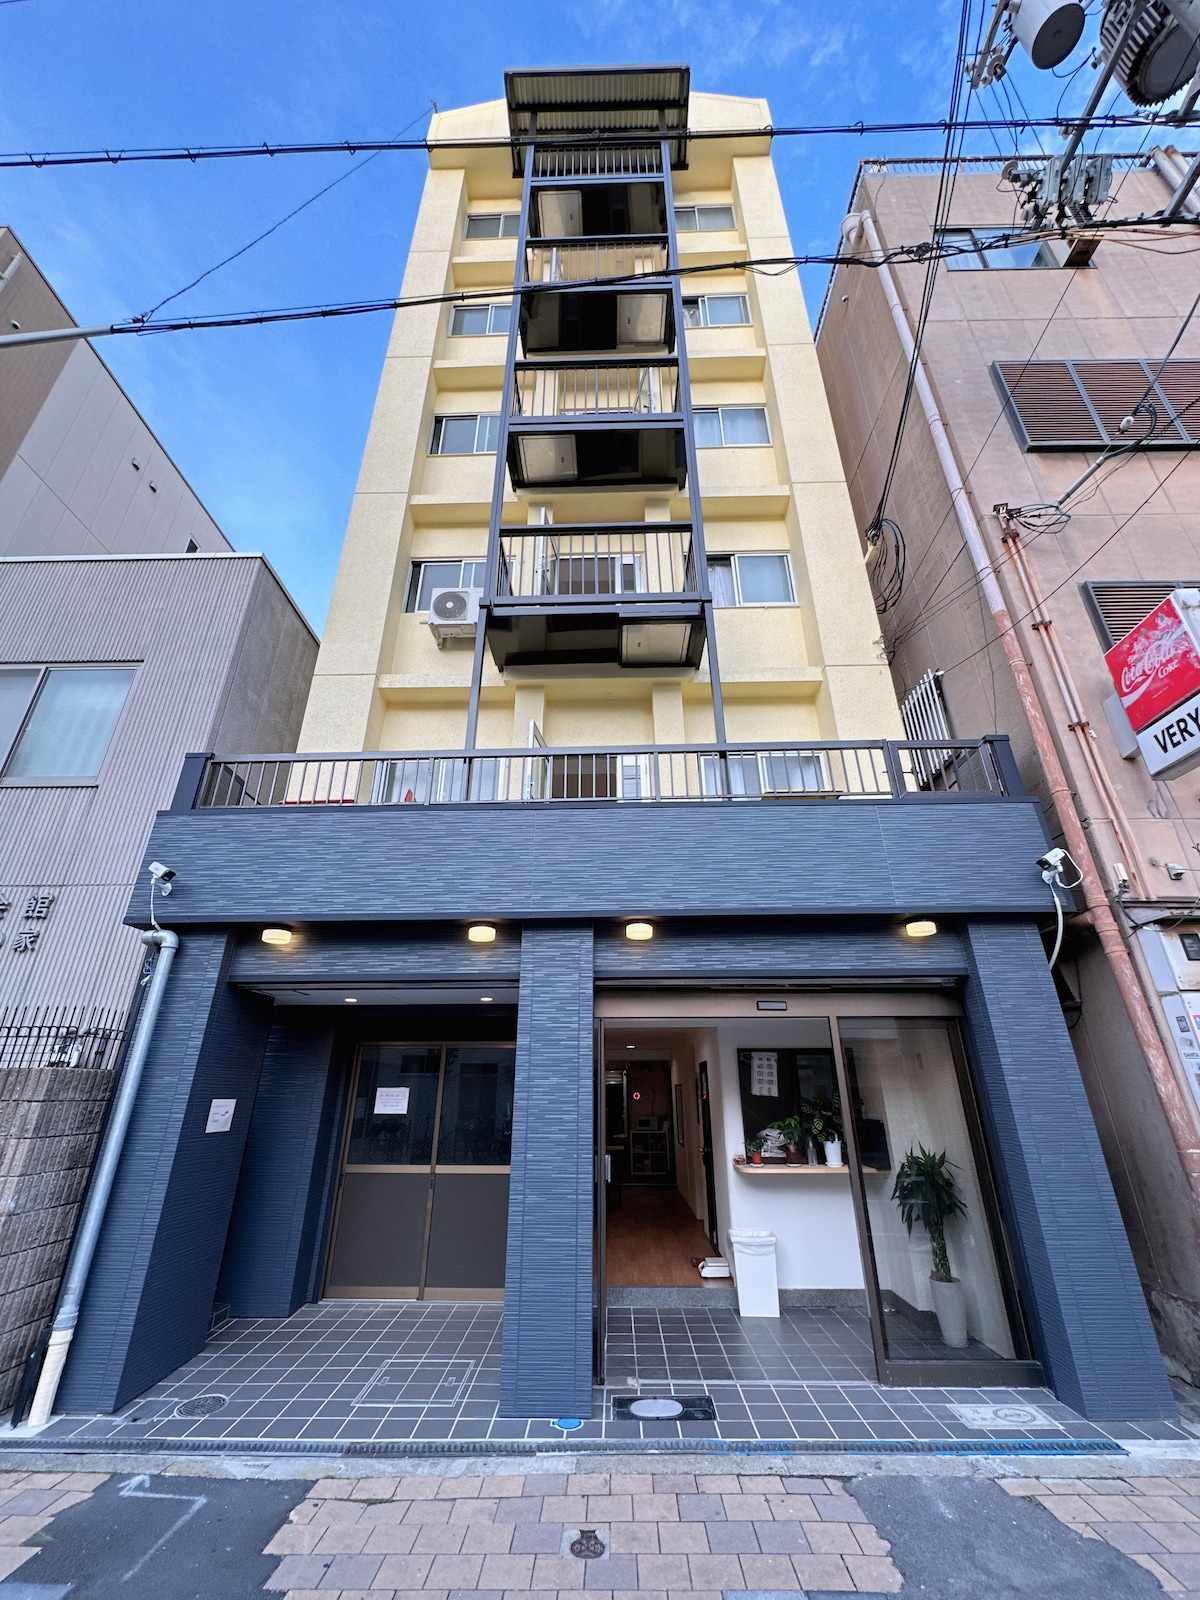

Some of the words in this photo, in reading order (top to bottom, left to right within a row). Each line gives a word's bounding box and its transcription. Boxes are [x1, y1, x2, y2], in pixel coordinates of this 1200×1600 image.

[1157, 659, 1180, 679] Coke
[1153, 706, 1200, 754] VERY
[0, 929, 40, 953] 家
